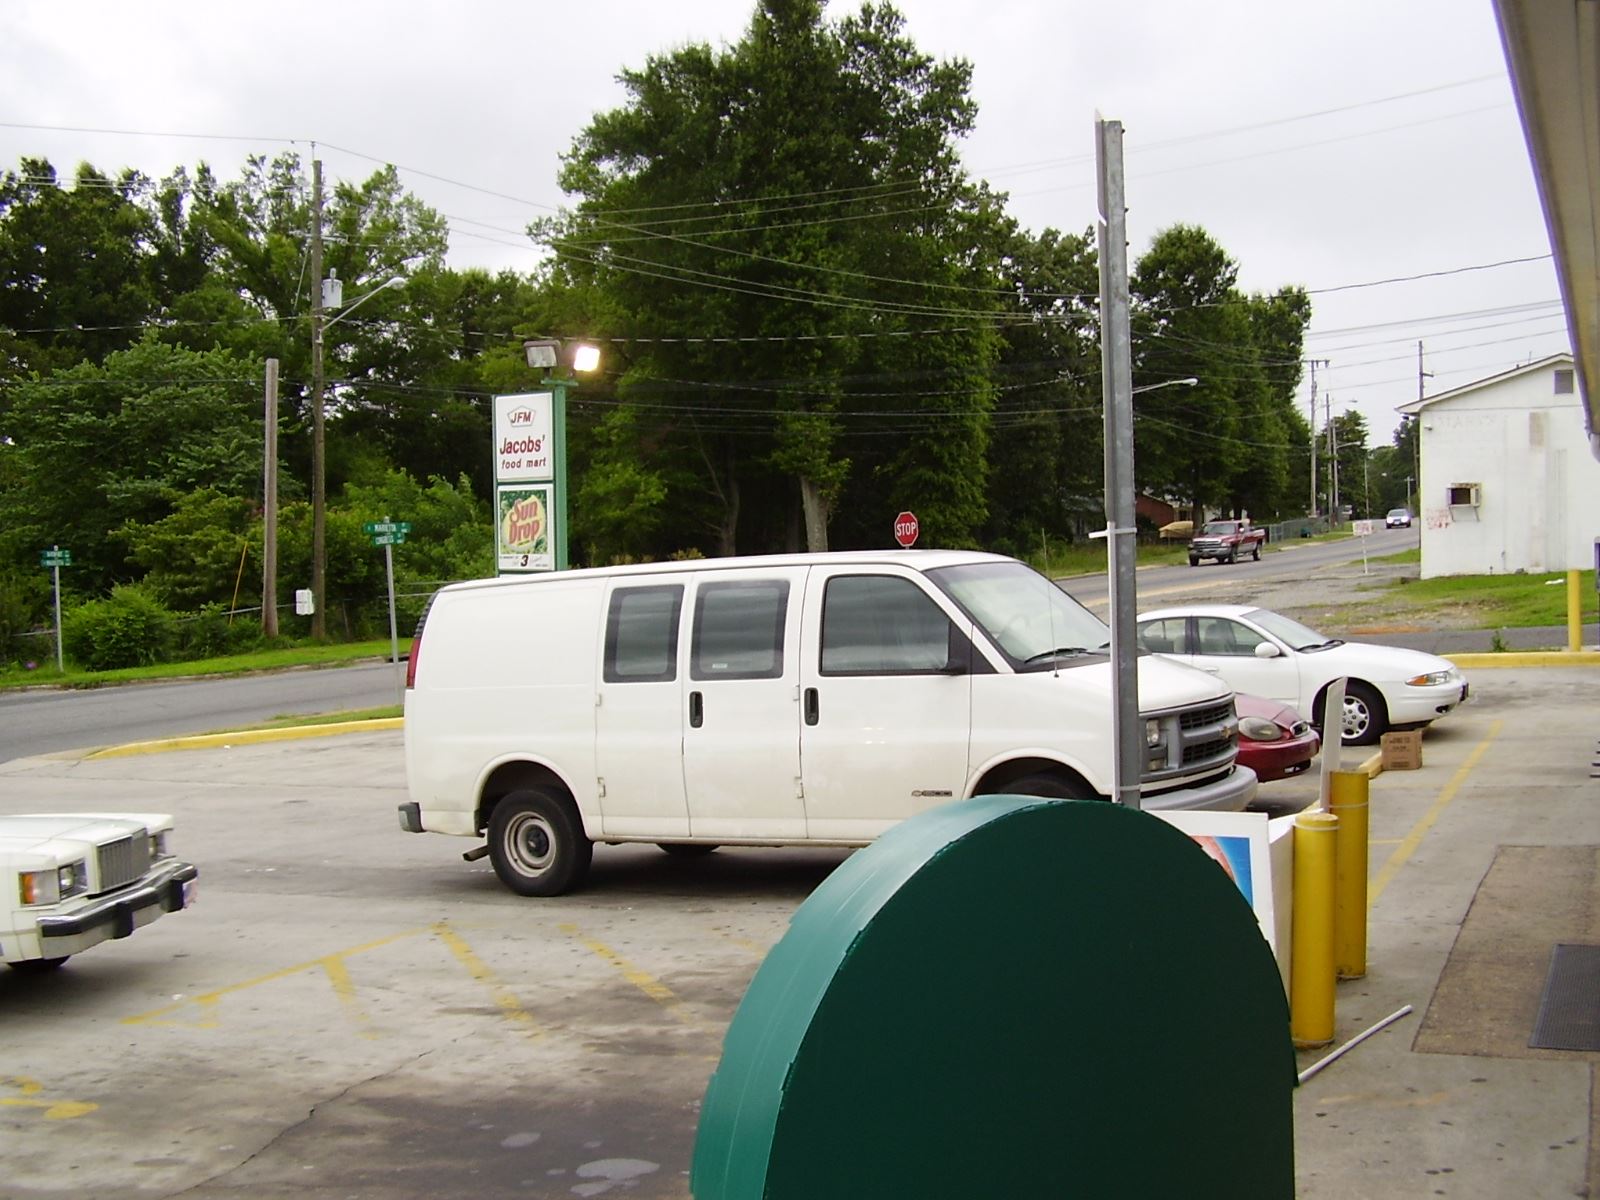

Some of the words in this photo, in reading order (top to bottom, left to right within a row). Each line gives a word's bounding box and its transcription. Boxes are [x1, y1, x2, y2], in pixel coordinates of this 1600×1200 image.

[511, 411, 532, 424] JFM
[500, 434, 546, 455] Jacobs'
[502, 458, 522, 469] food
[526, 457, 546, 468] mart
[509, 498, 538, 523] Sun
[508, 519, 540, 545] Drop
[896, 521, 916, 537] STOP
[520, 554, 529, 567] 3
